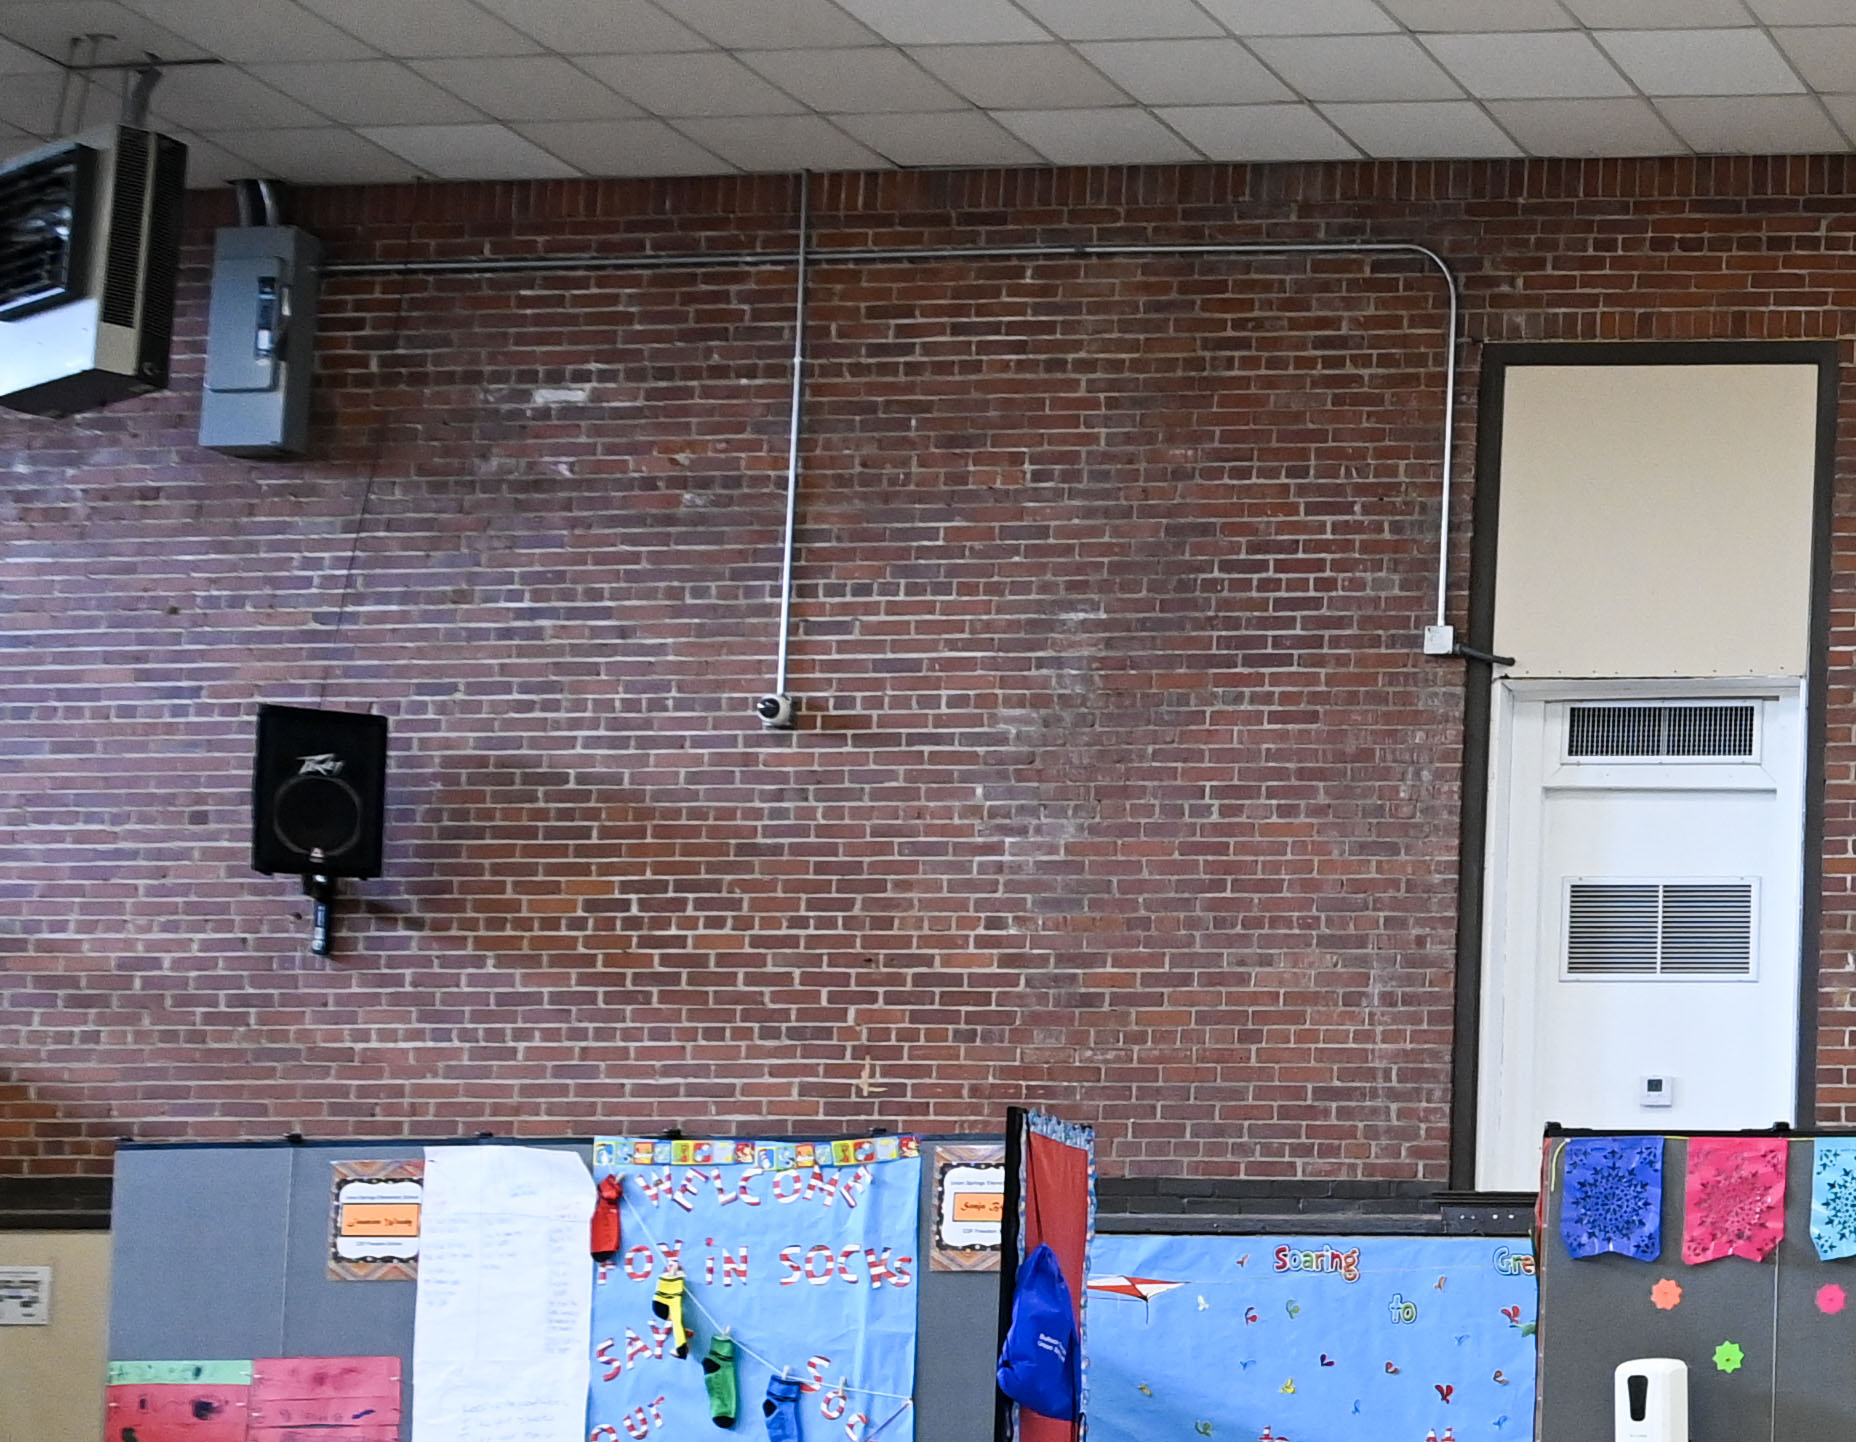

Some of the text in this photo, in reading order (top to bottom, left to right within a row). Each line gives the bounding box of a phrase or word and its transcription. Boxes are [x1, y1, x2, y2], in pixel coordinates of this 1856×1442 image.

[635, 1165, 873, 1211] WELCOME
[1273, 1244, 1361, 1283] Soaring
[1388, 1293, 1418, 1324] to
